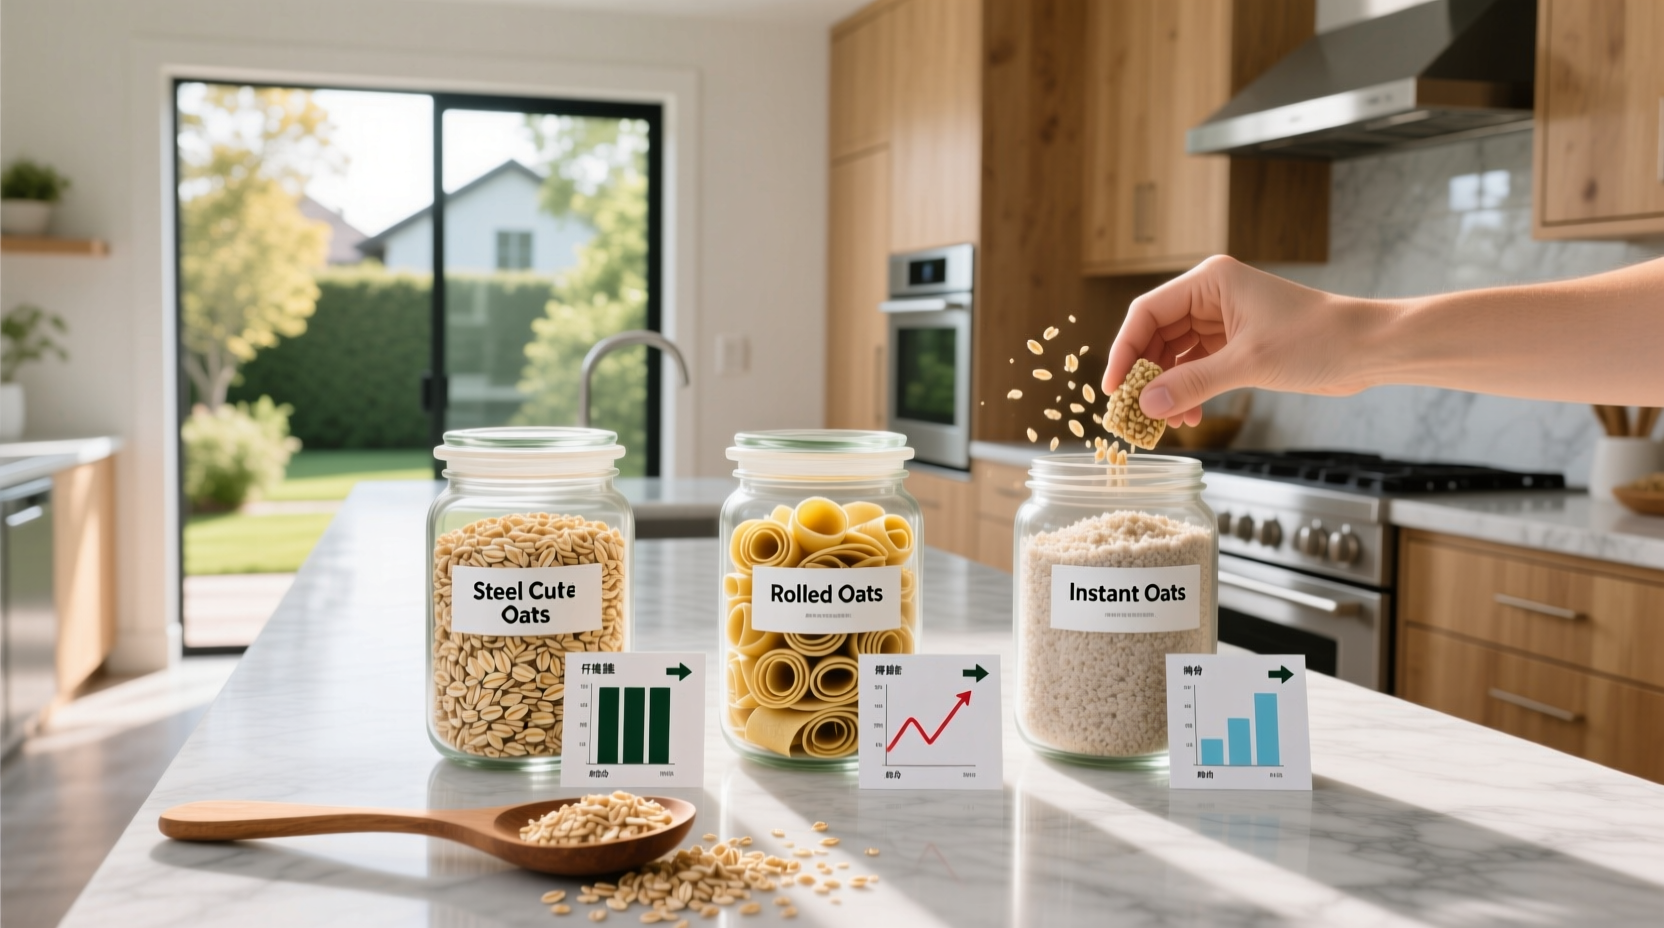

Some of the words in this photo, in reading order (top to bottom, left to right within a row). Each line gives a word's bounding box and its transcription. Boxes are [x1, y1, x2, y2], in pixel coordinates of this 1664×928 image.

[473, 581, 523, 600] Steel
[771, 583, 833, 604] Rolled
[838, 584, 883, 603] Oats
[1070, 582, 1140, 603] Instant
[1144, 583, 1186, 602] Oats
[501, 604, 550, 624] Oats
